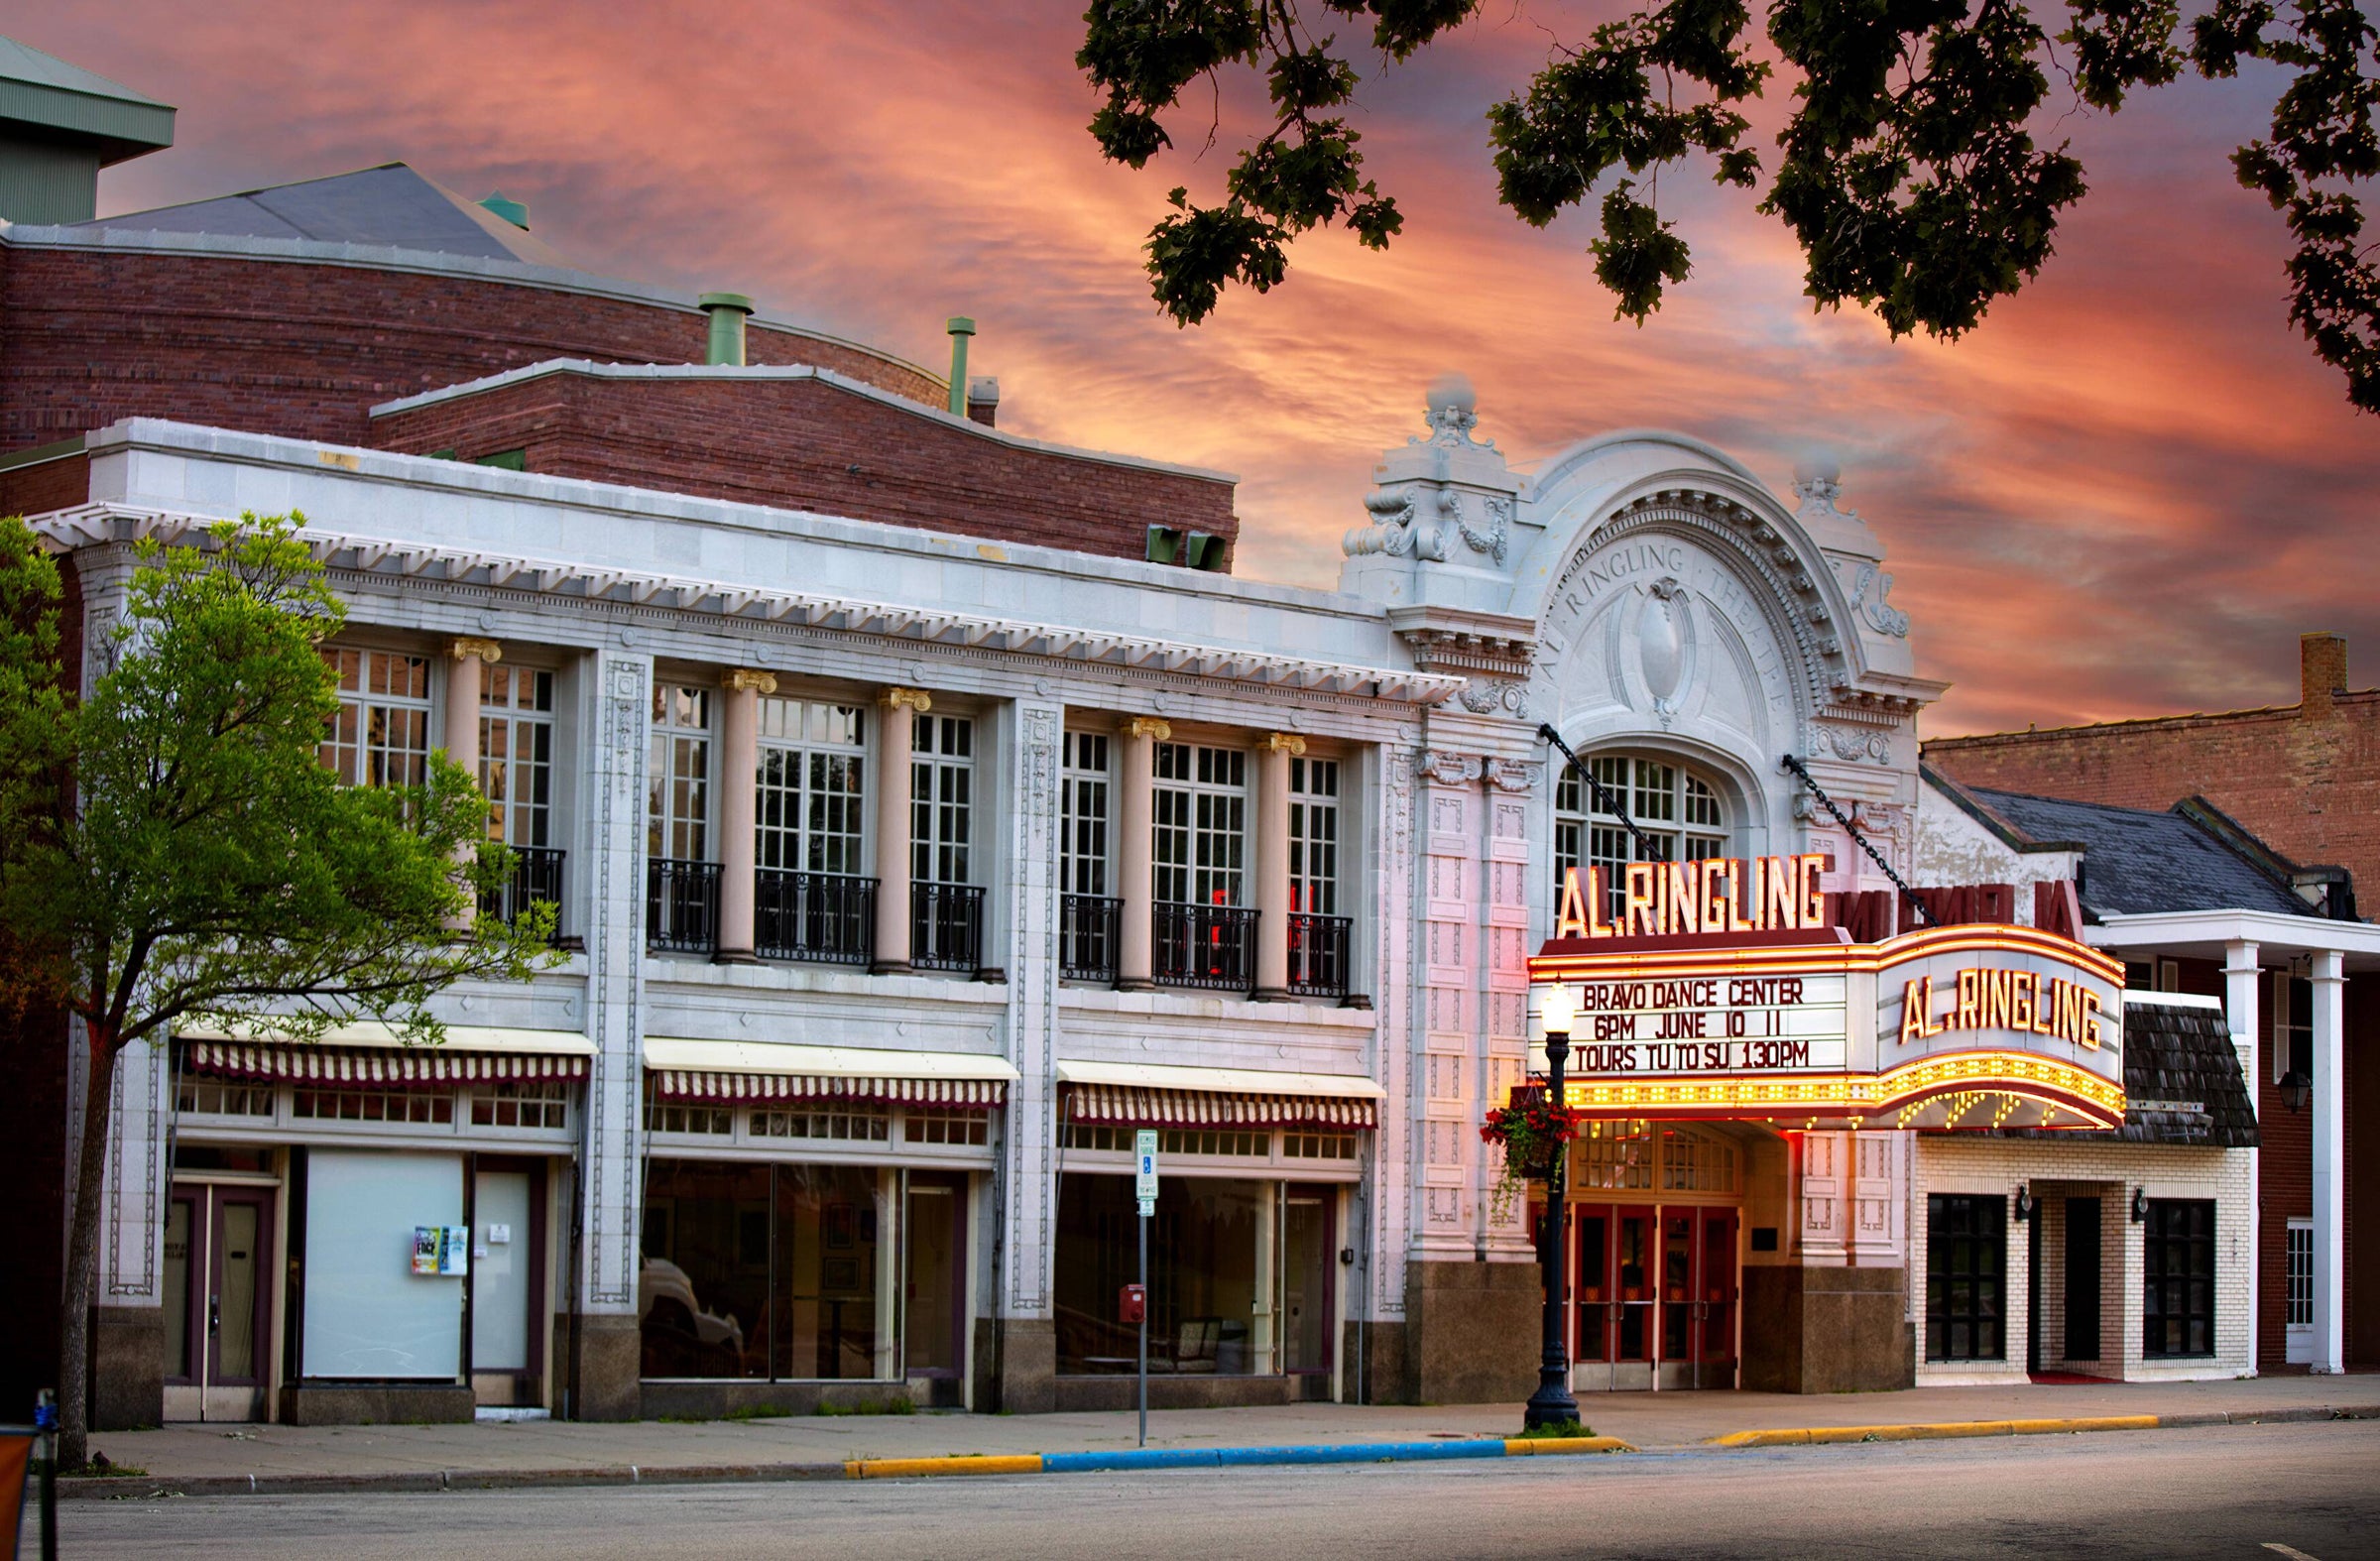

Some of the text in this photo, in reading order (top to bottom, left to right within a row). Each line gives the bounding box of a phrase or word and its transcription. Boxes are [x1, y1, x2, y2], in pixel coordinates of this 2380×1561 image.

[1565, 544, 1683, 616] RINGLING
[1625, 854, 1833, 936] RINGLING
[1584, 978, 1804, 1011] BRAVO DANCE CENTER
[1957, 968, 2101, 1051] RINGLING
[1595, 1010, 1780, 1040] 6PM JUNE 10 11
[1576, 1040, 1810, 1071] TOURS TU TO SU 130PM
